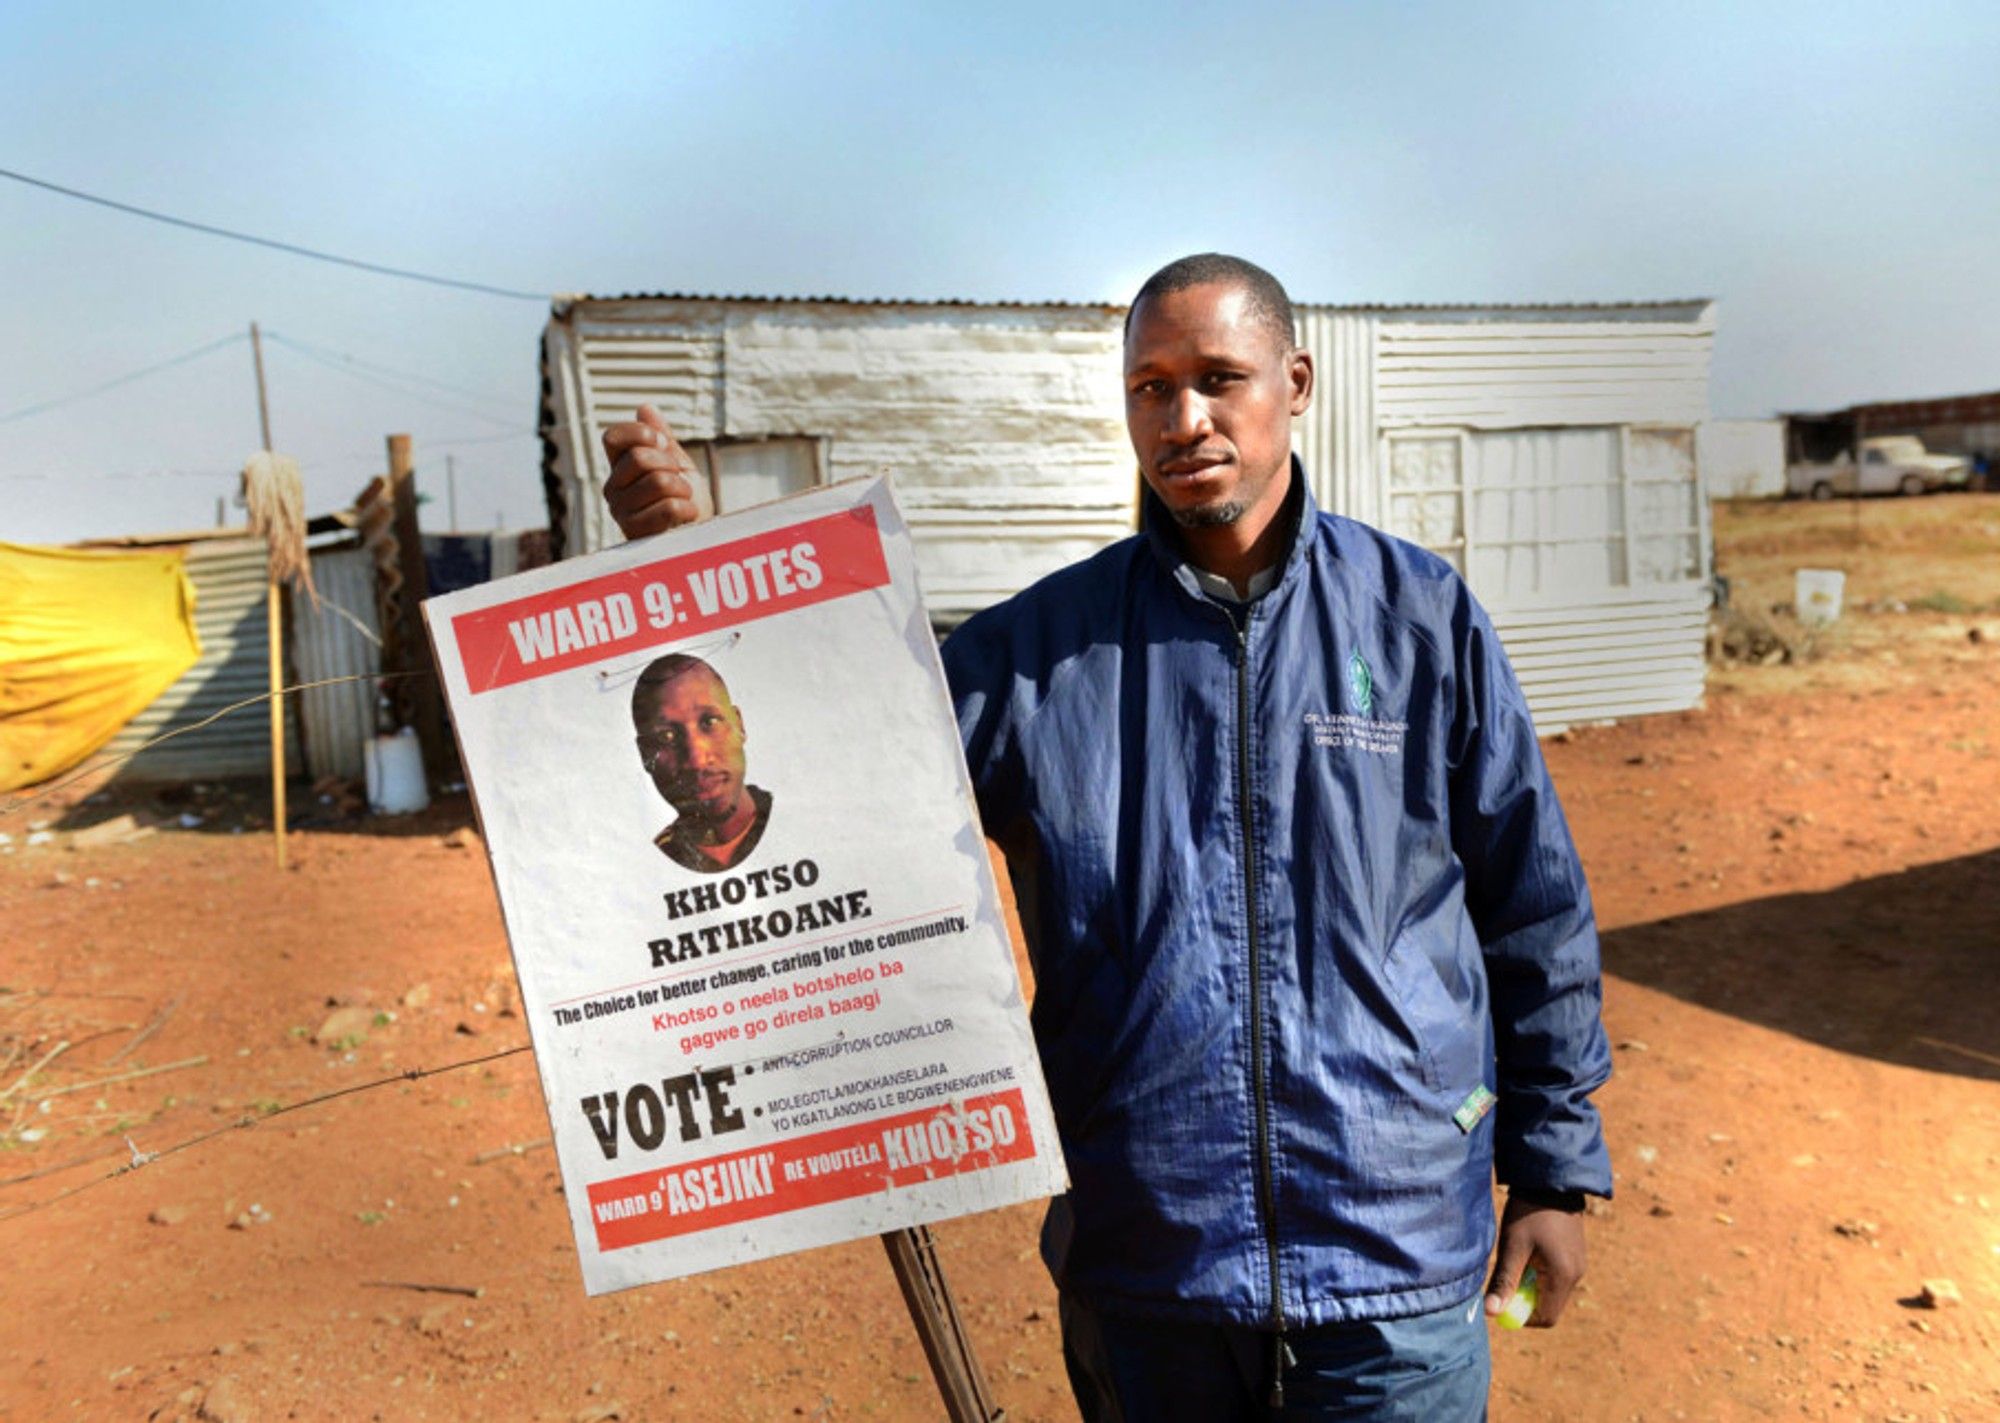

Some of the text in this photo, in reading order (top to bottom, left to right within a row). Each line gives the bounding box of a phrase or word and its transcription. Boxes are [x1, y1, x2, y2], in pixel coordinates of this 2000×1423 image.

[509, 542, 823, 664] WARD 9: VOTES
[663, 859, 819, 920] KHOTSO
[647, 890, 872, 968] RATIKOANE
[553, 1006, 582, 1027] The
[583, 994, 636, 1022] Choice
[637, 989, 659, 1006] for
[661, 977, 707, 1001] better
[772, 951, 822, 975] caring
[823, 944, 846, 962] for
[848, 936, 874, 955] the
[877, 915, 969, 950] community.
[652, 960, 904, 1032] Khotso o neela botshelo ba
[680, 989, 881, 1054] gagwe go direla baagi
[762, 1018, 954, 1073] ANTI-CORRUPTION COUNCILLOR
[580, 1064, 745, 1160] VOTE
[767, 1062, 948, 1114] MOLEGOTLA/MOKHANSELARA
[771, 1066, 1016, 1132] YO KGATLANONG LE BOGWENENGWENE
[594, 1194, 648, 1224] WARD
[650, 1193, 663, 1211] 9
[783, 1161, 806, 1182] RE
[807, 1142, 882, 1177] VOUTELA
[881, 1104, 1017, 1171] KHOTSO
